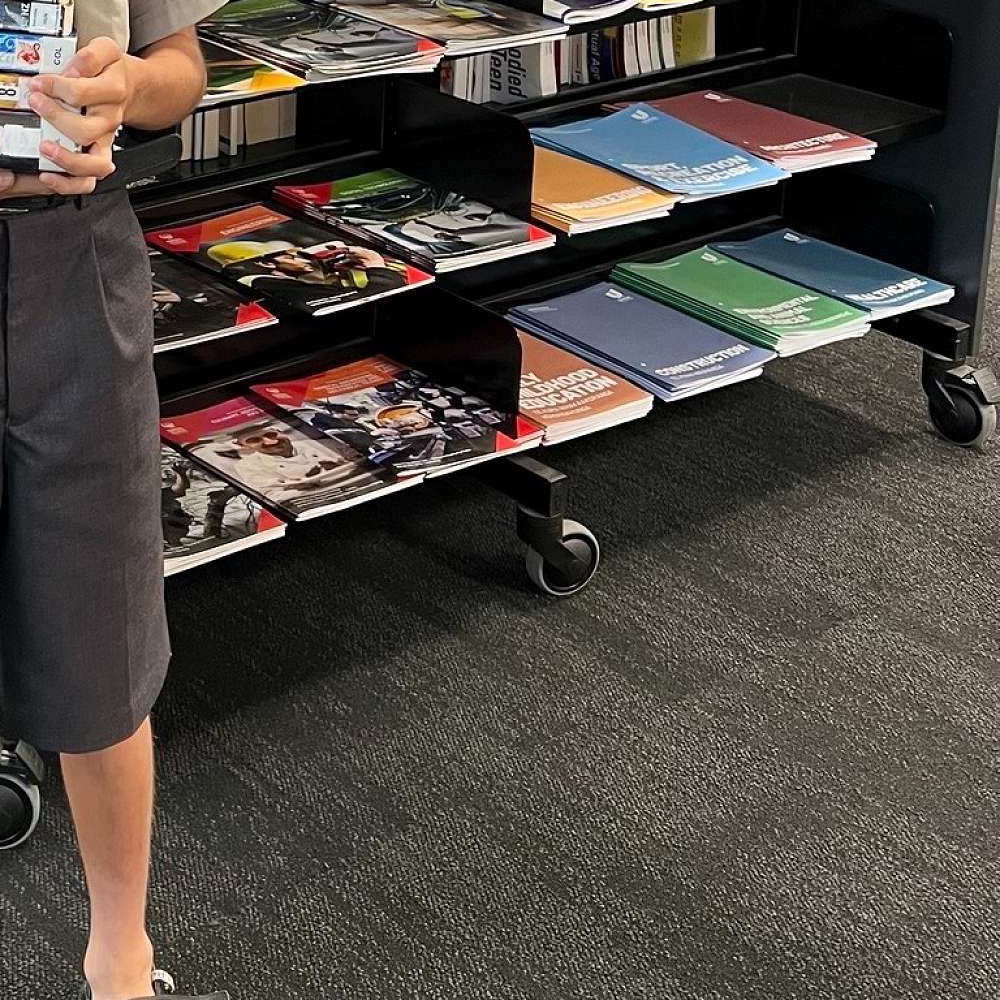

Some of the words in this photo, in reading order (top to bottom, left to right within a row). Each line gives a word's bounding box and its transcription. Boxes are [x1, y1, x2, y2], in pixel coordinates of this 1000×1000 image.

[490, 50, 508, 92] Teen
[507, 47, 527, 99] odied
[654, 343, 751, 377] CONSTRUCTION
